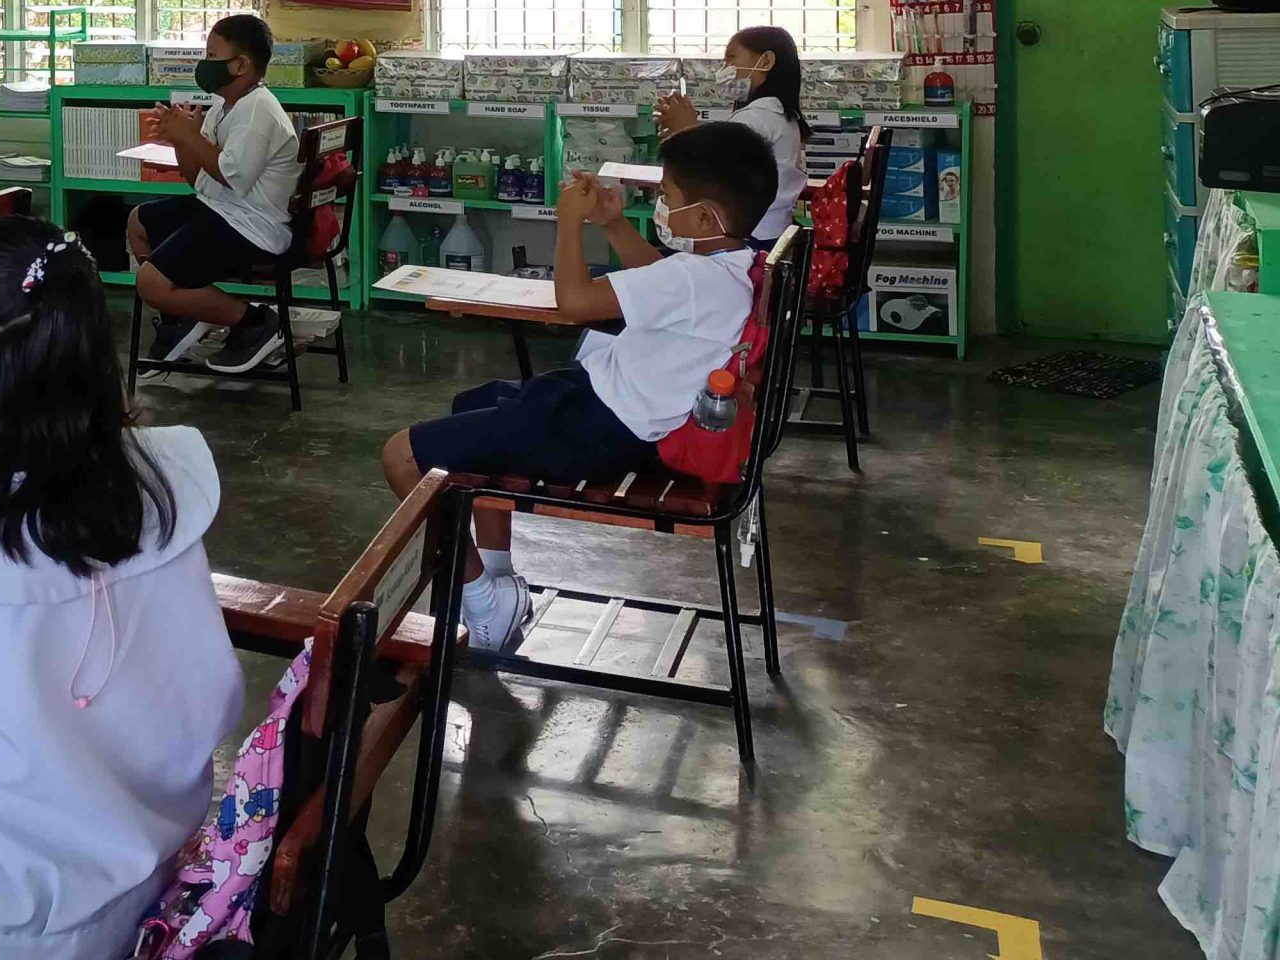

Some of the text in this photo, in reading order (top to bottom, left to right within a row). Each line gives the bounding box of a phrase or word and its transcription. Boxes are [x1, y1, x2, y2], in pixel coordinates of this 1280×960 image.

[389, 102, 436, 110] TOOTHPASTE
[883, 115, 938, 123] FACESHIELD
[409, 201, 443, 209] ALCOHOL
[896, 229, 938, 237] MACHINE
[875, 273, 949, 286] Fog Machine
